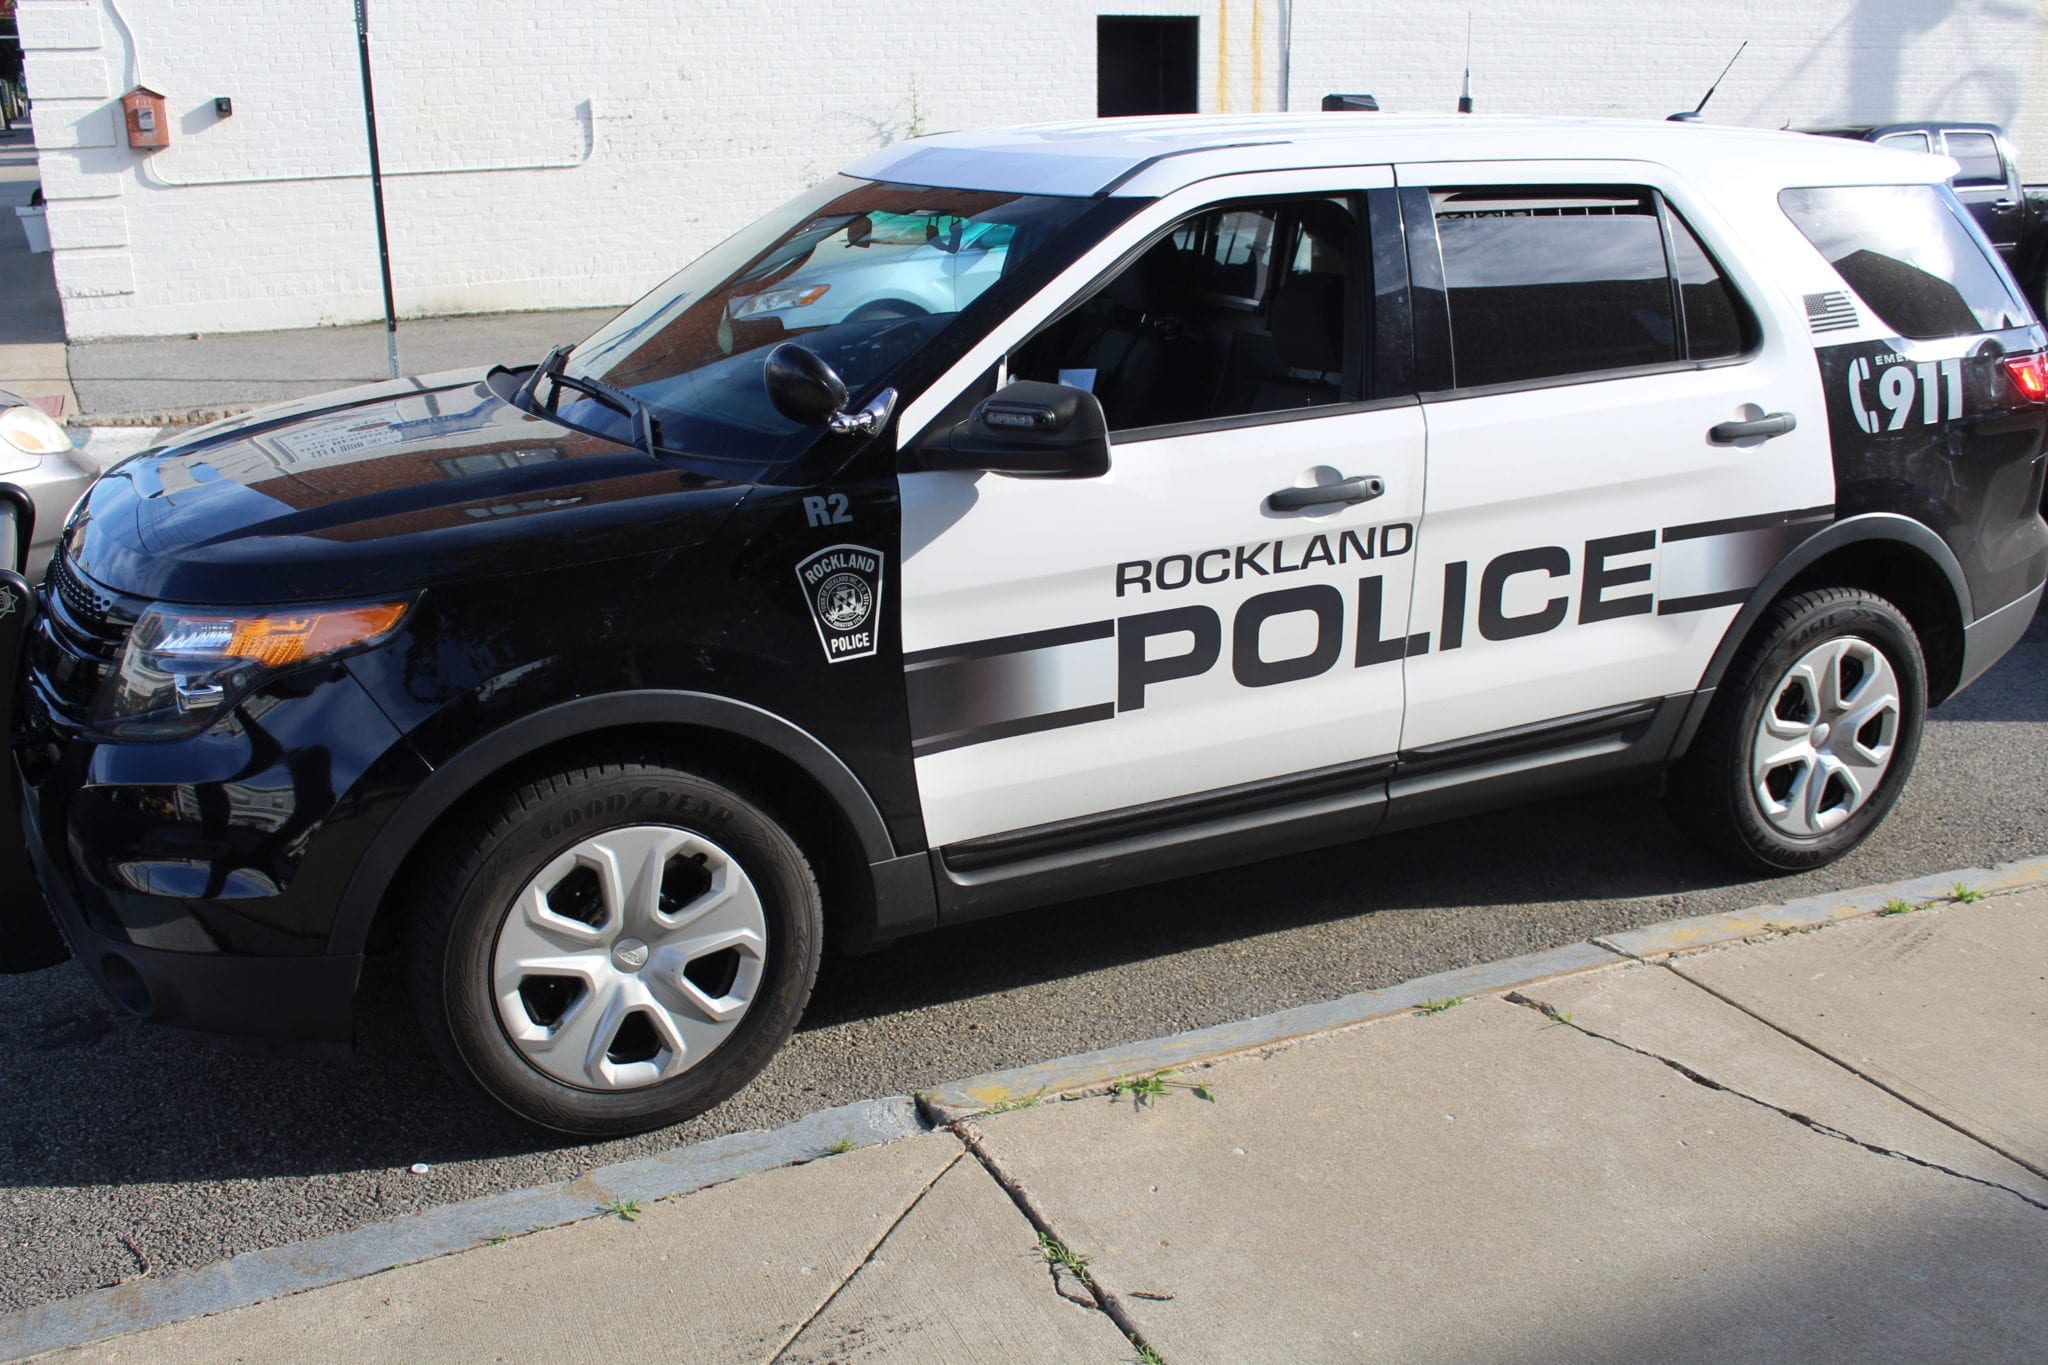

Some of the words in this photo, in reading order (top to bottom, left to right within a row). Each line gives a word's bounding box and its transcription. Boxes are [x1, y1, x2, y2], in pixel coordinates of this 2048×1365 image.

[1879, 358, 1963, 431] 911
[803, 493, 854, 528] R2
[804, 553, 876, 585] ROCKLAND
[1115, 521, 1414, 597] ROCKLAND
[830, 632, 871, 654] POLICE
[1117, 529, 1657, 714] POLICE
